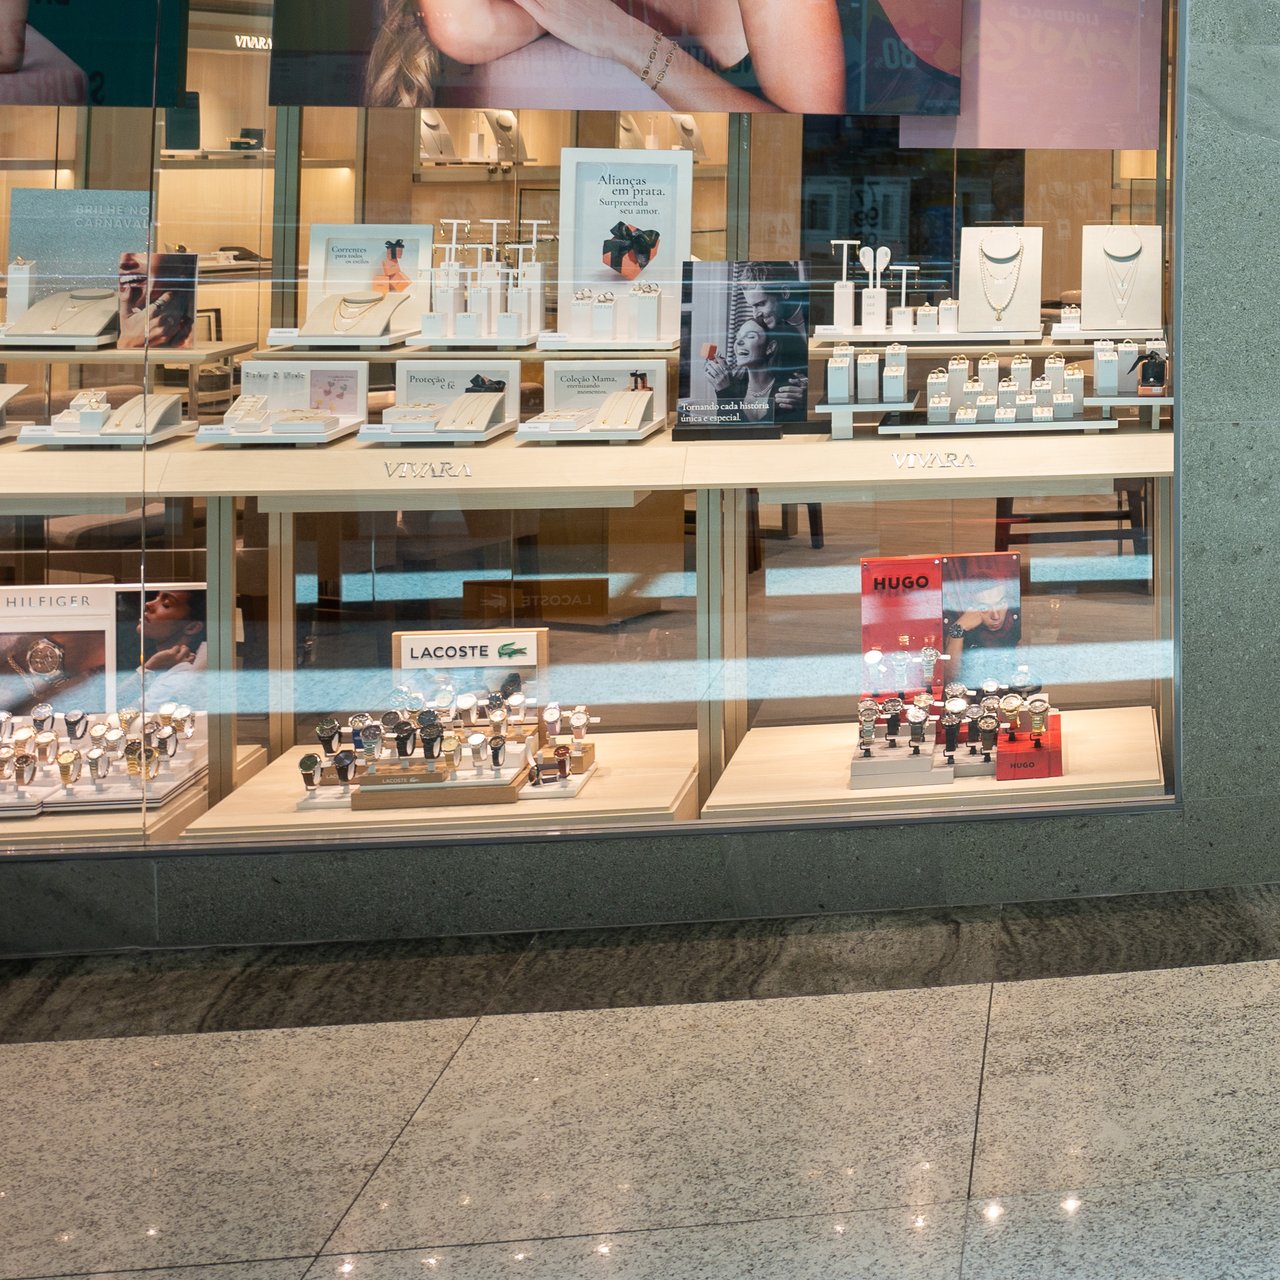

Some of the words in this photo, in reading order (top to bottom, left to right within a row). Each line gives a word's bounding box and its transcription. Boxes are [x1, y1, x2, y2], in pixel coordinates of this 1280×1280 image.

[234, 34, 273, 50] VIVARA
[598, 174, 647, 189] Alianças
[611, 188, 629, 196] em
[632, 187, 666, 200] prata.
[599, 197, 649, 208] Surpreenda
[76, 204, 124, 215] BRILHE
[130, 206, 150, 216] NO
[75, 218, 149, 229] CARNAVAL
[409, 375, 446, 385] Proteção
[560, 375, 590, 384] Coleção
[682, 402, 719, 411] Tornando
[720, 402, 739, 410] cada
[739, 401, 770, 410] história
[680, 414, 702, 423] única
[709, 412, 742, 424] especial.
[891, 452, 976, 469] VIVARA
[384, 461, 473, 478] VIVARA
[873, 575, 929, 590] HUGO
[6, 595, 90, 608] HILFIGER
[410, 645, 489, 659] LACOSTE
[1010, 761, 1035, 769] HUGO
